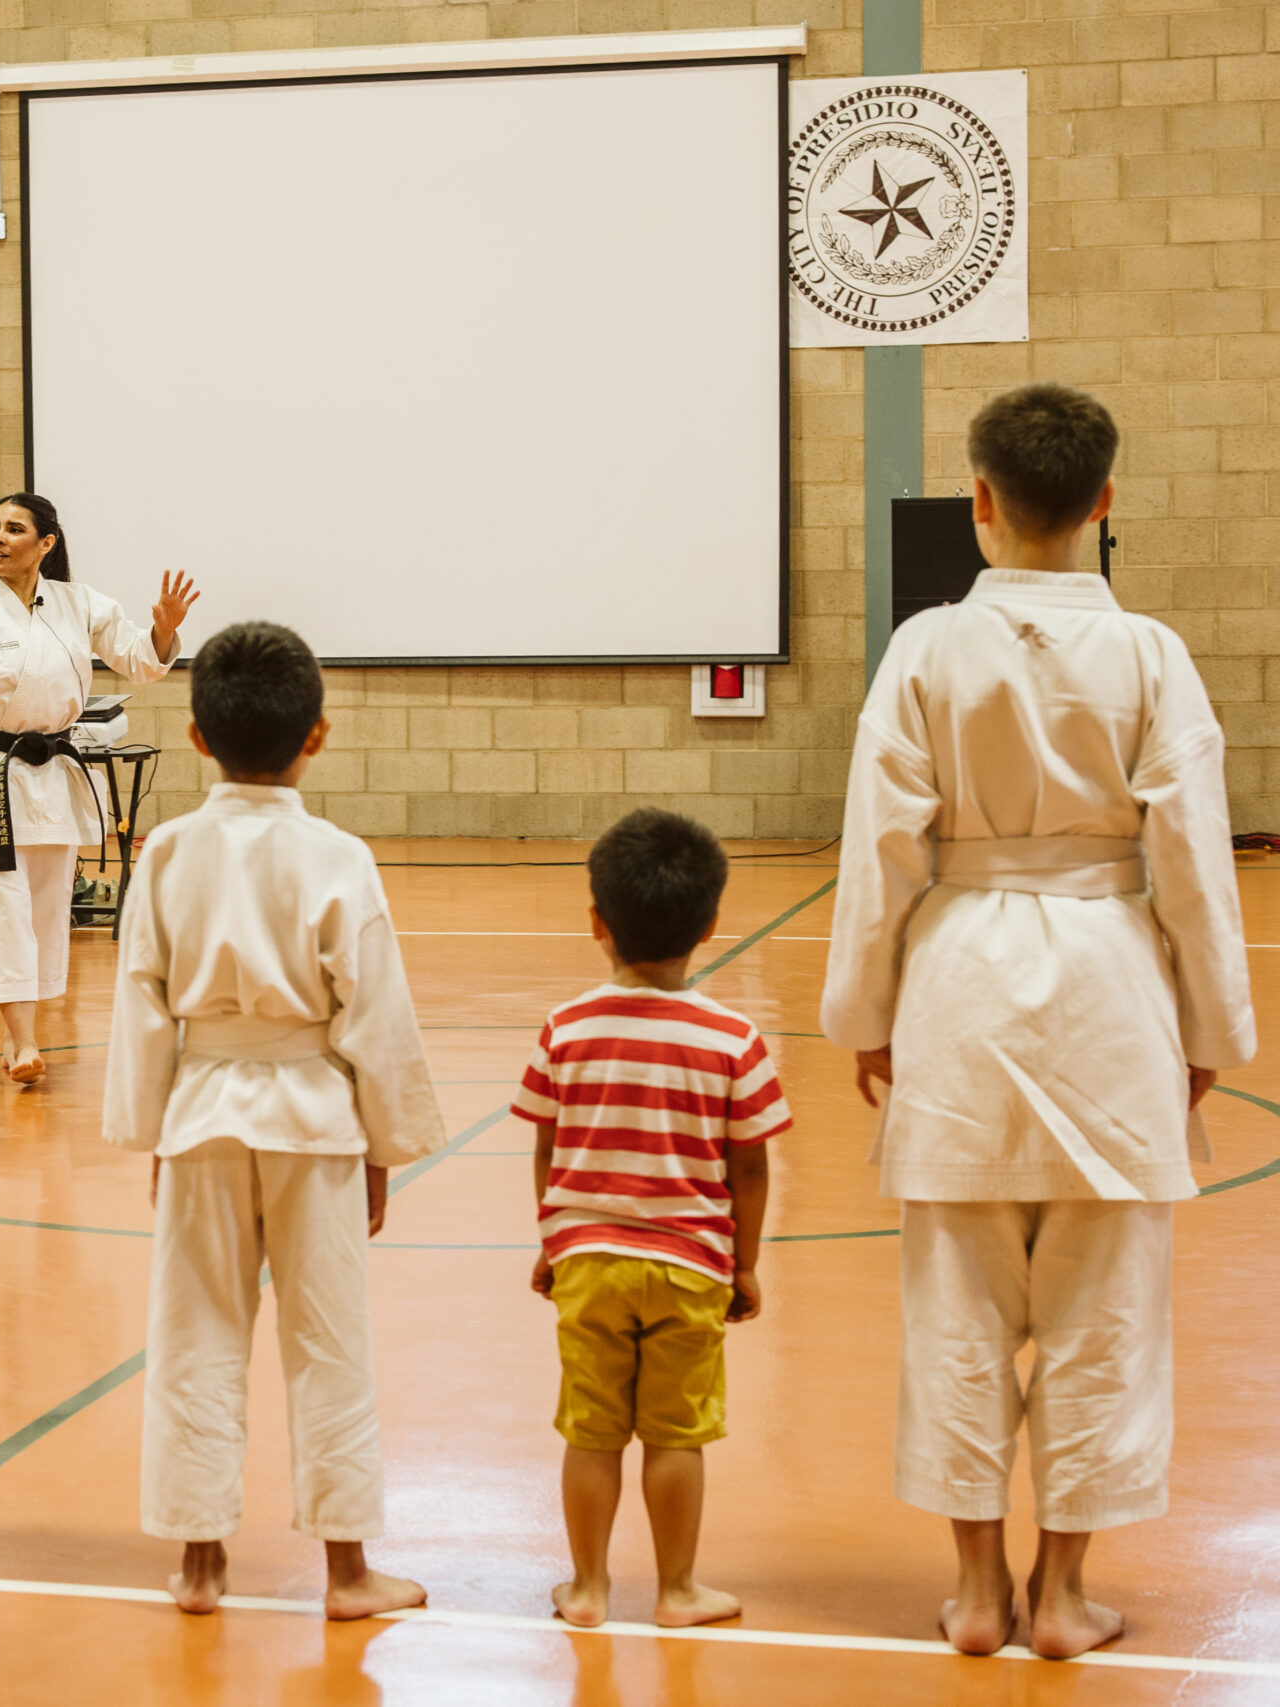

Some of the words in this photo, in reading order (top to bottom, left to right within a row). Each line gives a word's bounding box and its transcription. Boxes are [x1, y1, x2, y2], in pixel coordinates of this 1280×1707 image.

[796, 101, 919, 174] PRESIDIO
[946, 121, 998, 201] TEXAS
[788, 177, 807, 215] OF
[788, 227, 826, 285] CITY
[827, 282, 880, 317] THE
